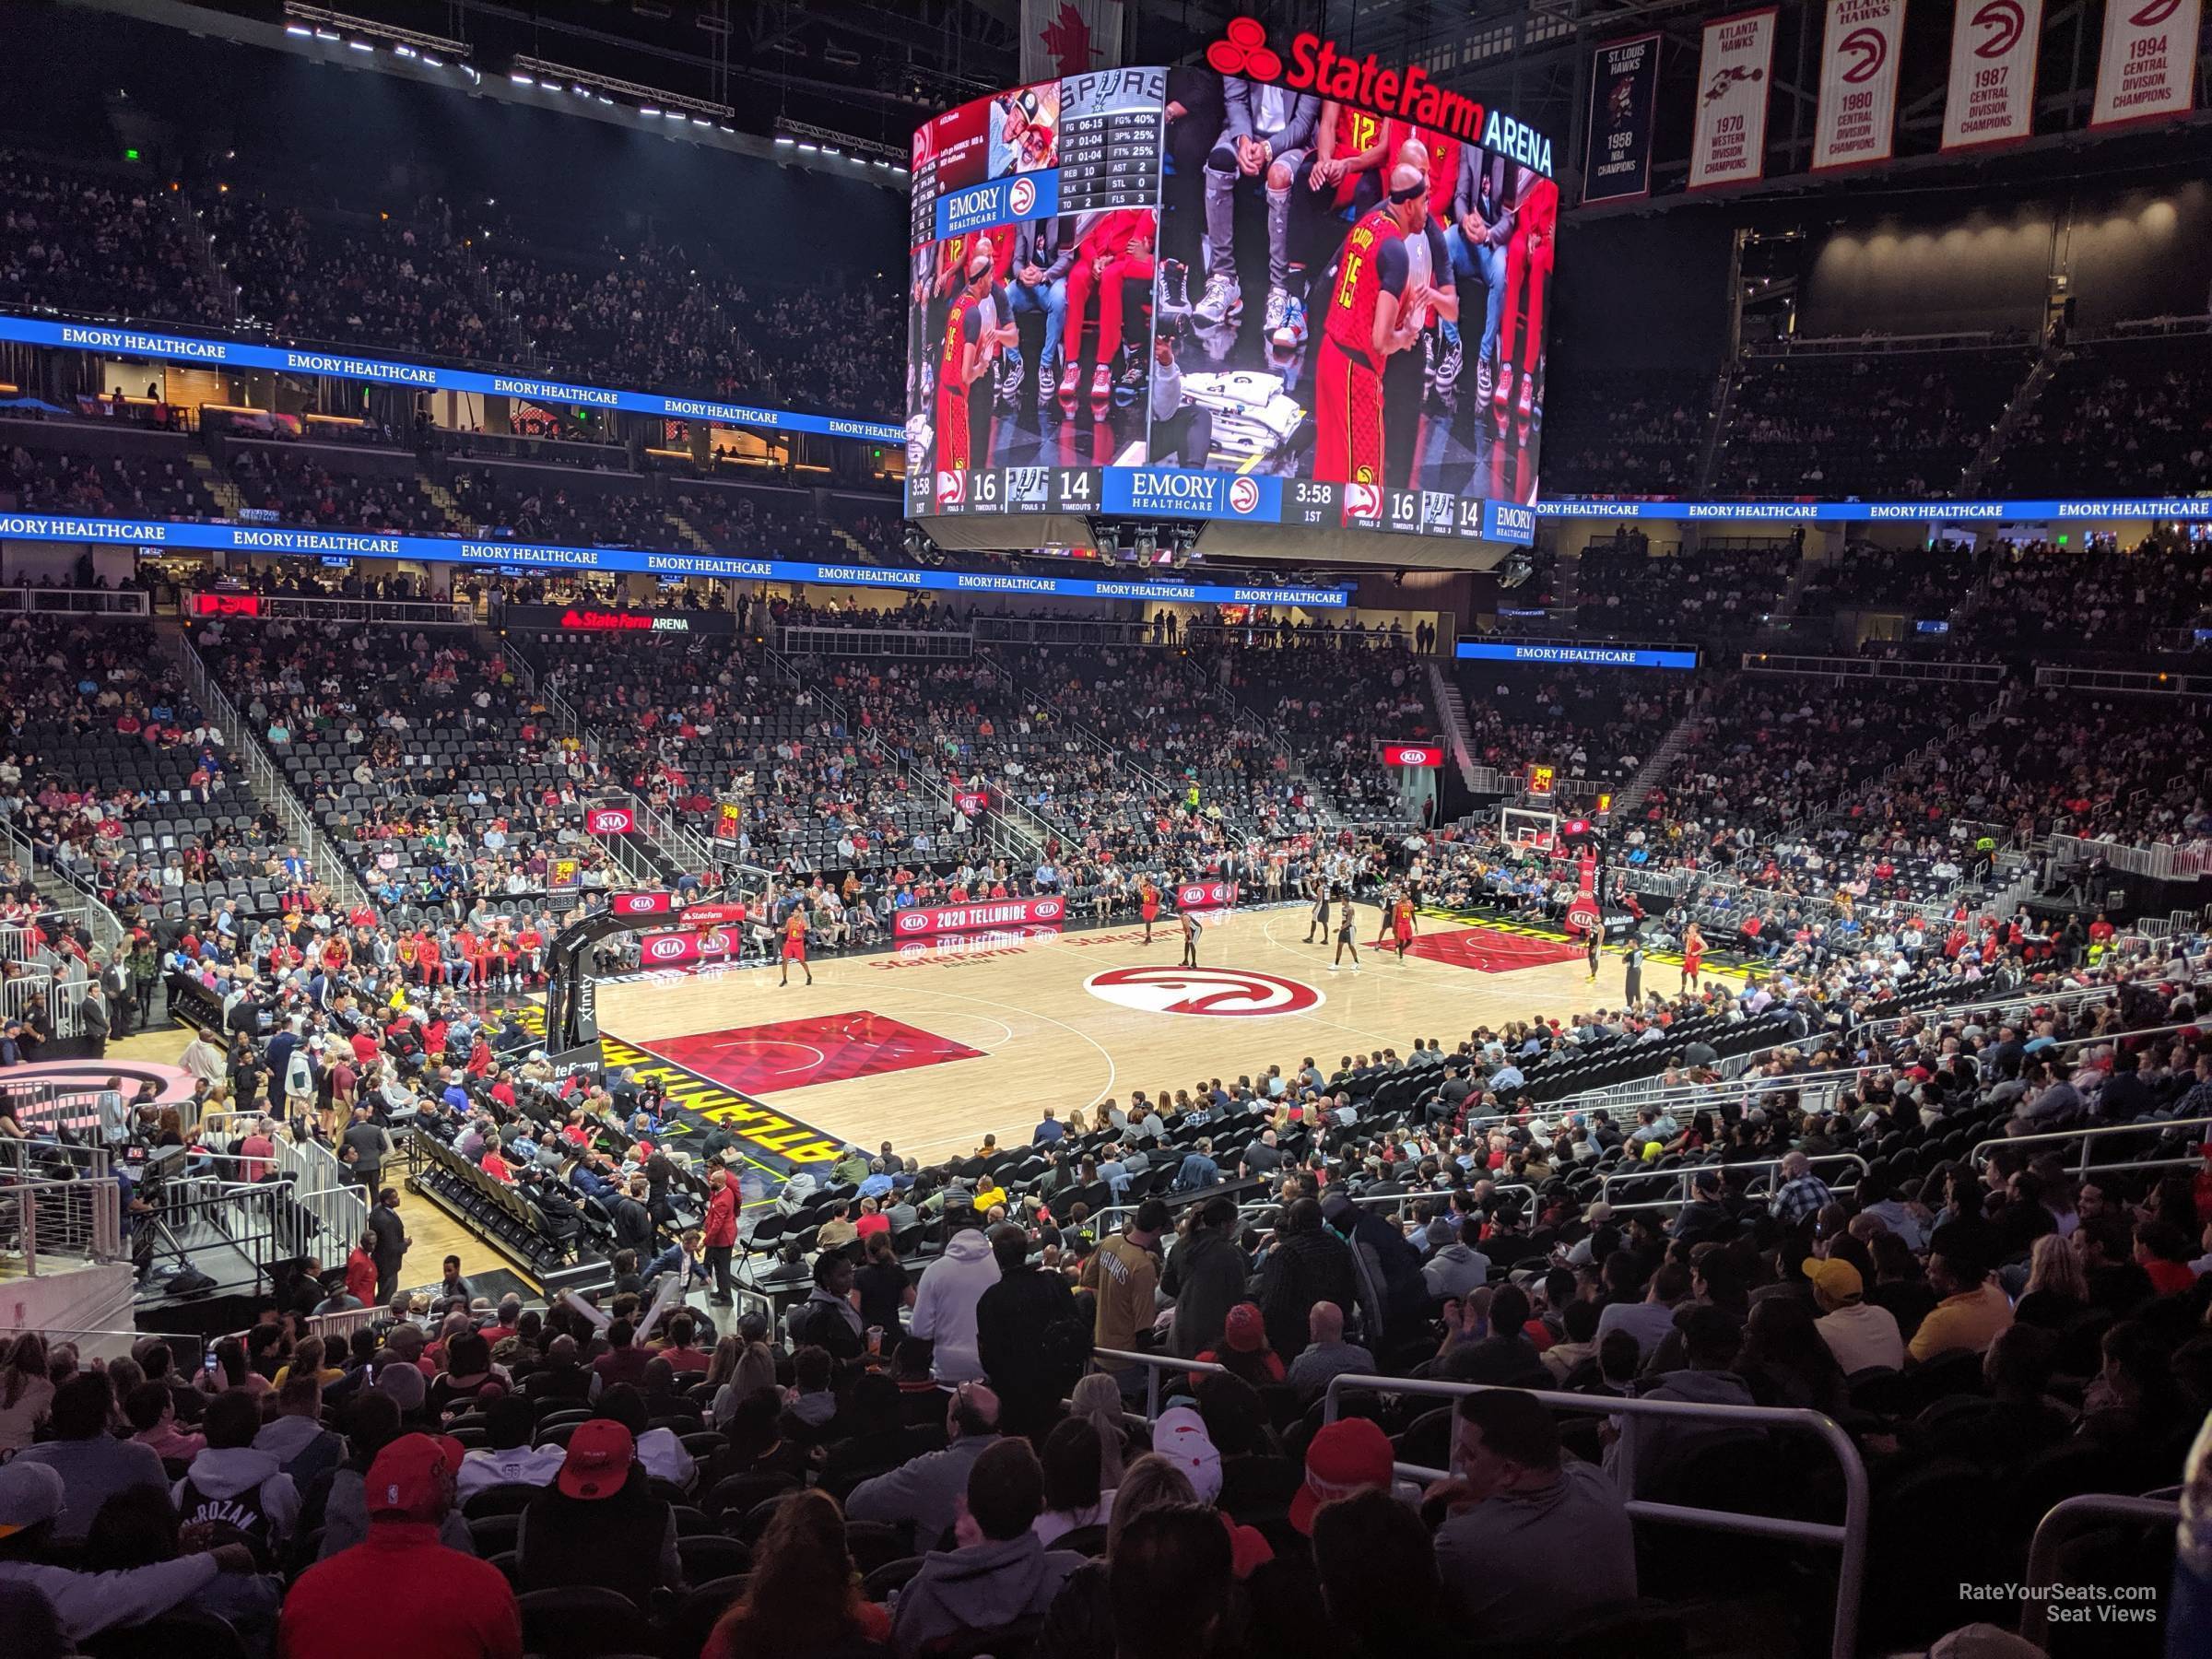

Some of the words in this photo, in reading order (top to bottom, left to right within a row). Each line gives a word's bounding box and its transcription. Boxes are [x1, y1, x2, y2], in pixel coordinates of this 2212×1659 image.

[1840, 5, 1889, 25] HAWKS
[1719, 22, 1758, 41] ATLANTA
[1722, 35, 1754, 53] HAWKS
[2130, 35, 2167, 59] 1994
[1608, 51, 1619, 63] ST.
[1621, 45, 1645, 61] LOUIS
[1611, 58, 1641, 75] HAWKS
[2124, 57, 2168, 76] CENTRAL
[1975, 66, 2008, 88] 1987
[2123, 73, 2165, 91] DIVISION
[1061, 70, 1164, 112] SPURS
[1970, 87, 2008, 104] CENTRAL
[2112, 88, 2171, 109] CHAMPIONS
[1843, 91, 1872, 112] 1980
[1970, 101, 2006, 119] DIVISION
[1079, 119, 1103, 130] 06-15
[1115, 116, 1131, 124] FG%
[1134, 114, 1155, 124] 40%
[1717, 116, 1743, 134] 1970
[1837, 111, 1872, 127] CENTRAL
[1960, 115, 2012, 134] CHAMPIONS
[1065, 139, 1074, 147] 3P
[1079, 135, 1102, 146] 01-04
[1115, 132, 1131, 140] 3P%
[1134, 130, 1155, 140] 25%
[1353, 112, 1375, 153] 12
[1607, 132, 1632, 149] 1958
[1712, 133, 1746, 147] WESTERN
[1836, 125, 1871, 140] DIVISION
[1485, 111, 1552, 177] ARENA
[1830, 137, 1876, 155] CHAMPIONS
[1065, 154, 1073, 162] FT
[1078, 150, 1101, 161] 01-04
[1113, 147, 1129, 157] FT%
[1133, 146, 1154, 156] 25%
[1611, 150, 1624, 161] NBA
[1712, 147, 1742, 159] DIVISION
[1065, 169, 1077, 178] REB
[1085, 167, 1095, 176] 10
[1112, 164, 1127, 172] AST
[1138, 162, 1146, 171] 2
[1598, 160, 1636, 176] CHAMPIONS
[1705, 159, 1747, 174] CHAMPIONS
[1064, 185, 1077, 194] BLK
[1112, 179, 1126, 188] STL
[1138, 178, 1145, 187] 0
[949, 187, 1000, 220] EMORY
[1085, 198, 1091, 207] 2
[1112, 195, 1125, 204] FLS
[1138, 194, 1145, 204] 3
[949, 212, 996, 231] HEALTHCARE
[1339, 251, 1361, 309] 15
[64, 329, 121, 346] EMORY
[125, 336, 225, 358] HEALTHCARE
[288, 355, 340, 371] EMORY
[345, 361, 435, 382] HEALTHCARE
[495, 380, 538, 394] EMORY
[542, 385, 617, 404] HEALTHCARE
[665, 401, 705, 414] EMORY
[708, 406, 777, 427] HEALTHCARE
[830, 421, 863, 433] EMORY
[865, 421, 909, 441] HEALTHC
[912, 477, 930, 496] 3:58
[974, 474, 996, 501] 16
[1060, 471, 1090, 500] 14
[1132, 473, 1218, 499] EMORY
[1296, 483, 1332, 504] 3:58
[916, 503, 925, 513] 1ST
[1133, 498, 1213, 512] HEALTHCARE
[1392, 493, 1414, 520] 16
[1461, 501, 1478, 527] 14
[1535, 501, 1566, 513] ORY
[1565, 505, 1638, 514] HEALTHCARE
[1689, 506, 1733, 515] EMORY
[1736, 507, 1817, 516] HEALTHCARE
[1871, 507, 1916, 516] EMORY
[1919, 506, 2002, 516] HEALTHCARE
[2059, 504, 2110, 515] EMORY
[2112, 503, 2208, 514] HEALTHCARE
[1304, 510, 1322, 523] 1ST
[1497, 507, 1532, 529] EMORY
[0, 519, 47, 533] MORY
[52, 522, 164, 539] HEALTHCARE
[1393, 523, 1414, 531] TIMEOUTS
[1497, 528, 1530, 539] HEALTHCARE
[234, 532, 292, 547] EMORY
[297, 532, 398, 552] HEALTHCARE
[463, 546, 510, 559] EMORY
[513, 548, 597, 563] HEALTHCARE
[649, 557, 693, 570] EMORY
[696, 560, 771, 574] HEALTHCARE
[818, 568, 855, 579] EMORY
[858, 571, 920, 582] HEALTHCARE
[959, 576, 992, 586] EMORY
[994, 578, 1054, 590] HEALTHCARE
[1097, 584, 1129, 594] EMORY
[1132, 586, 1194, 597] HEALTHCARE
[1235, 591, 1273, 600] EMORY
[1275, 592, 1342, 603] HEALTHCARE
[653, 618, 688, 630] ARENA
[1517, 648, 1558, 658] EMORY
[1560, 650, 1635, 662] HEALTHCARE
[1405, 753, 1422, 762] KIA
[1534, 777, 1549, 791] 24
[597, 815, 623, 826] KIA
[720, 817, 735, 836] 24
[555, 872, 570, 885] 24
[634, 900, 650, 908] KIA
[1187, 891, 1202, 900] KIA
[905, 918, 923, 927] KIA
[936, 912, 966, 928] 2020
[970, 905, 1027, 924] TELLURIDE
[1040, 904, 1055, 914] KIA
[1574, 913, 1593, 924] KIA
[657, 942, 680, 955] KIA
[578, 973, 595, 1023] xfinity
[1100, 1250, 1129, 1286] HAWKS
